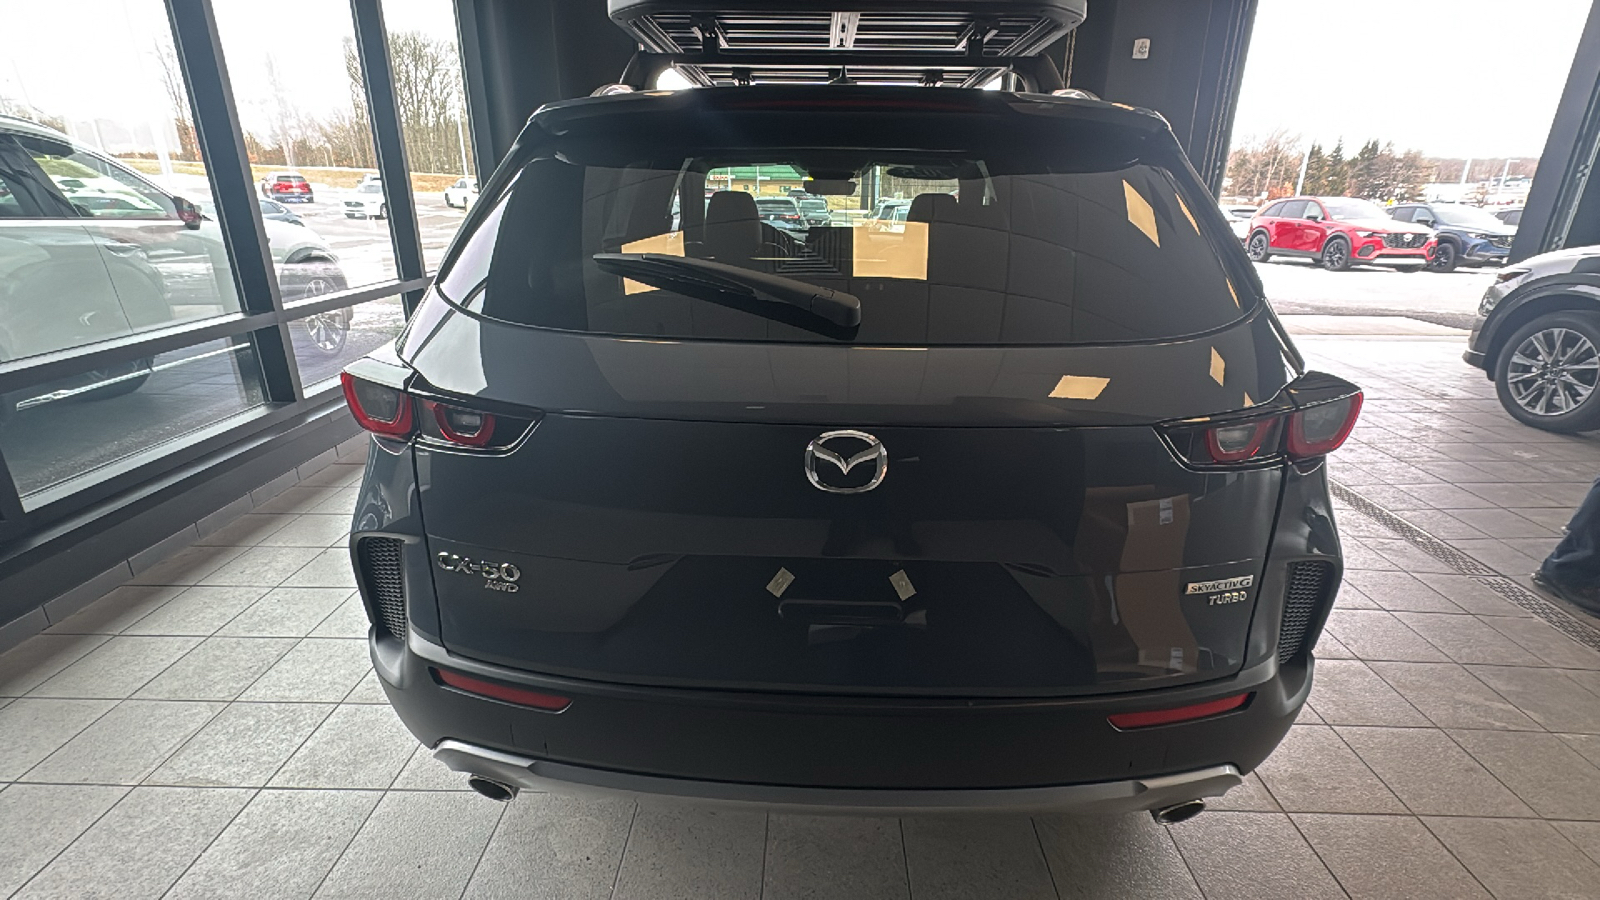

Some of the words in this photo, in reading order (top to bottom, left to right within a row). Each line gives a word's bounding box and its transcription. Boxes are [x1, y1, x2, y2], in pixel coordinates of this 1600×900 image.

[437, 551, 521, 582] CX-50
[484, 579, 519, 593] AWD
[1208, 590, 1248, 606] TURBO
